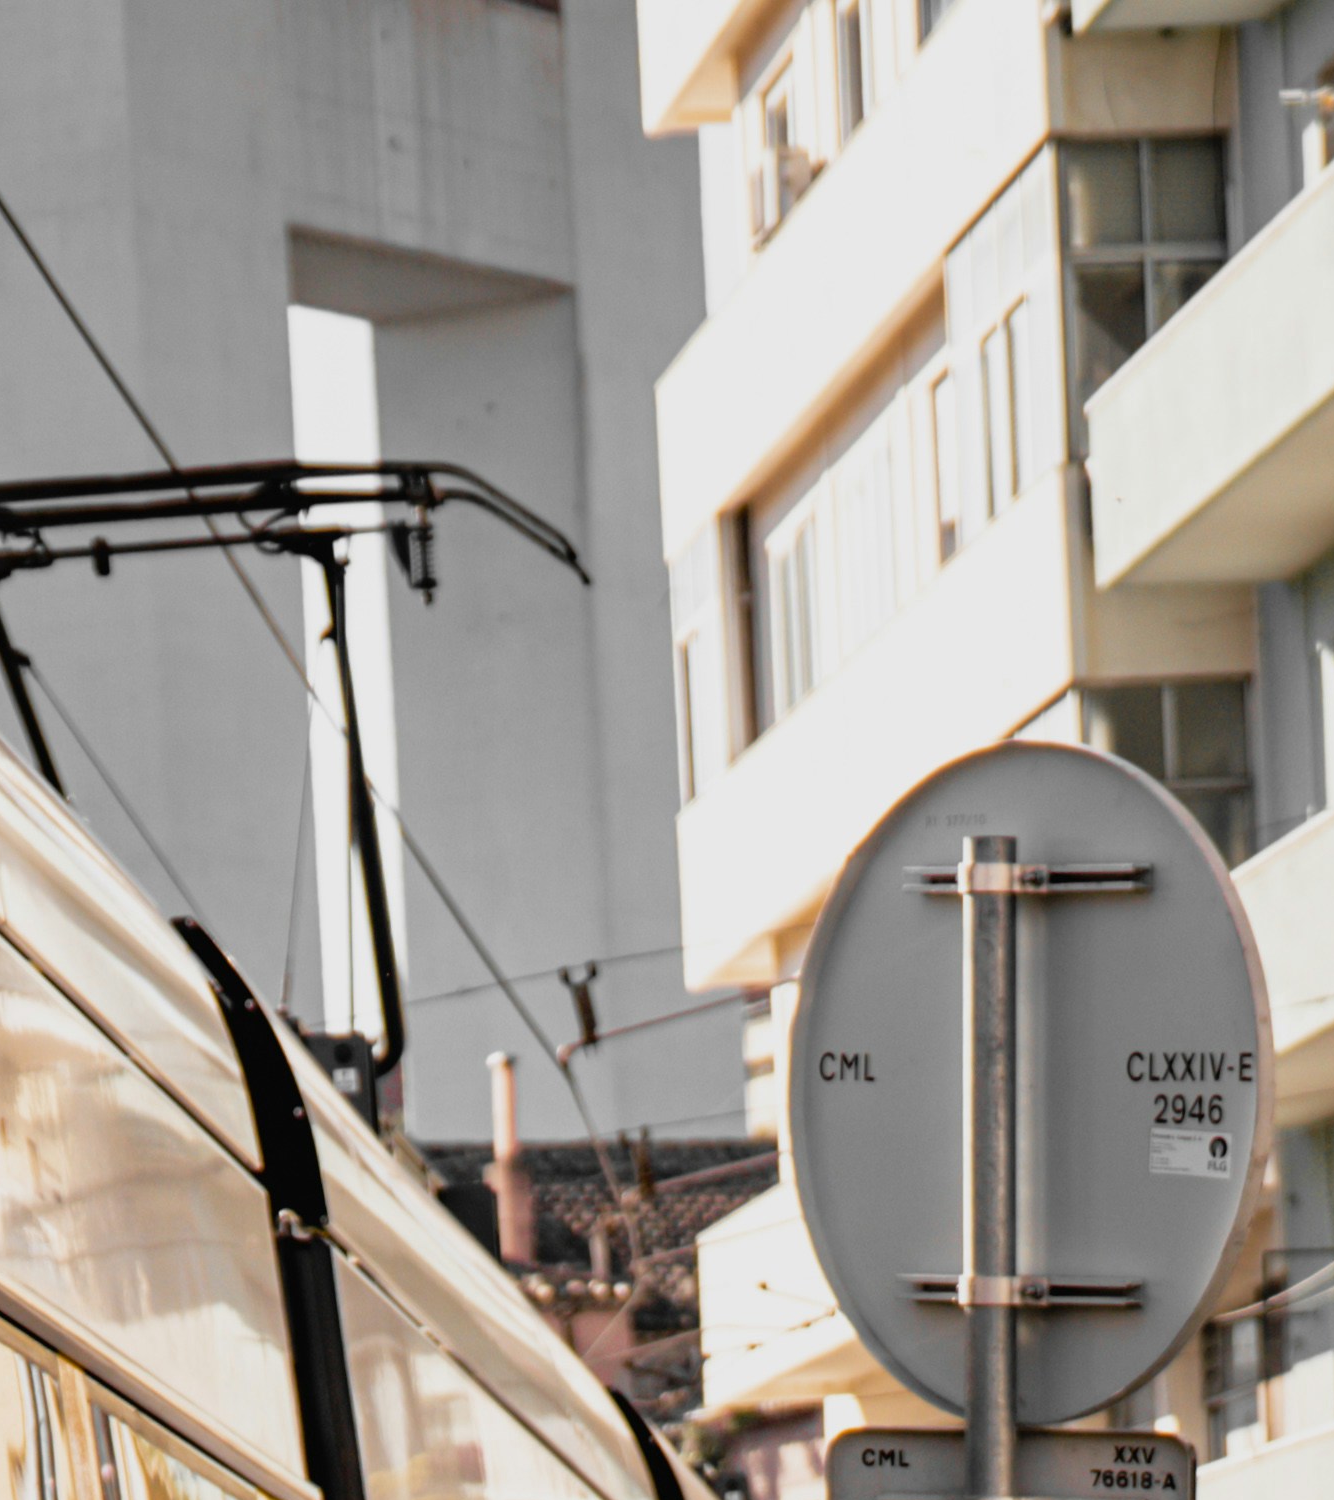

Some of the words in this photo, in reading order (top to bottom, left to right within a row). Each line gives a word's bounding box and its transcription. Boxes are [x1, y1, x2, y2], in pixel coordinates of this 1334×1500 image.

[819, 1051, 875, 1081] CML
[1127, 1051, 1254, 1082] CLXXIV-E
[1154, 1093, 1224, 1125] 2946
[862, 1450, 910, 1468] CML
[1114, 1446, 1157, 1464] XXV
[1091, 1470, 1177, 1490] 76618-A
